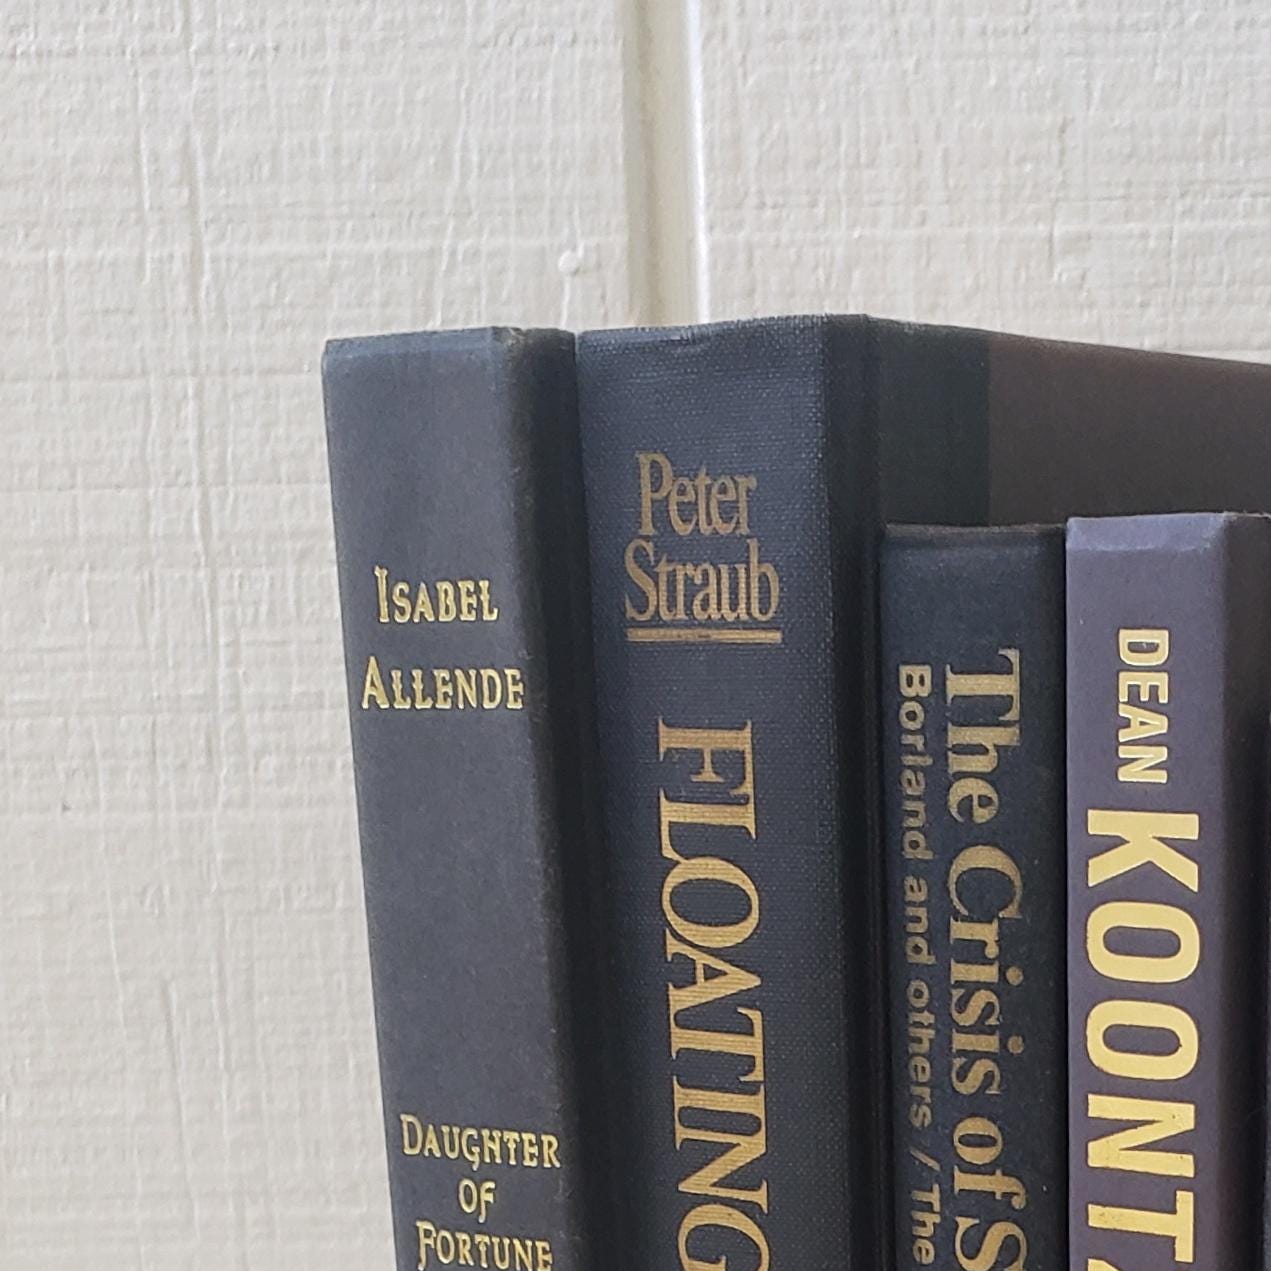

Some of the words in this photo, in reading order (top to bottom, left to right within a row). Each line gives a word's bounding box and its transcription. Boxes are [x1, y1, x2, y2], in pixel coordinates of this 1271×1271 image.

[635, 451, 757, 537] Peter
[373, 566, 499, 623] ISABEL
[624, 536, 781, 622] Straub
[361, 656, 525, 710] ALLENDE
[1116, 627, 1170, 785] DEAN
[898, 663, 935, 864] Borland
[945, 648, 1021, 825] The
[904, 876, 937, 967] and
[946, 844, 1024, 1097] Crisis
[904, 978, 940, 1131] others
[399, 1112, 561, 1171] DAUGHTER
[911, 1146, 941, 1173] /
[952, 1115, 1028, 1212] of
[912, 1183, 942, 1266] The
